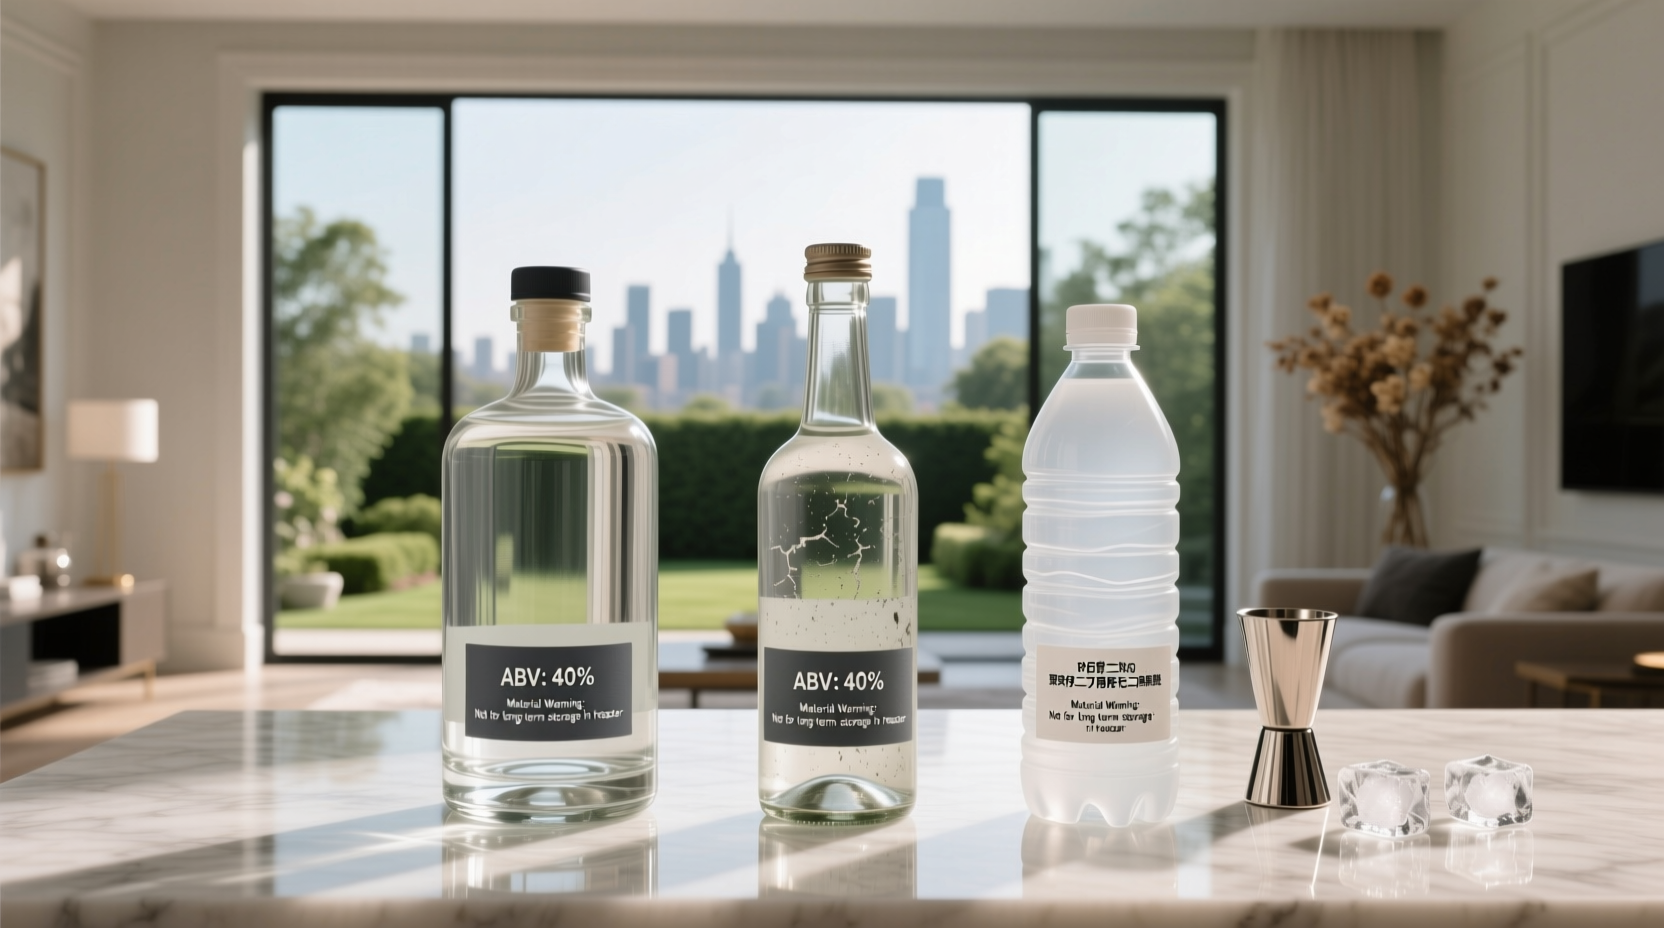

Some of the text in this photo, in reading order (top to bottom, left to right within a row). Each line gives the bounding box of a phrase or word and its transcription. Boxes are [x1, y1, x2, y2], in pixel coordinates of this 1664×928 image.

[500, 666, 595, 687] ABV: 40%
[793, 670, 884, 691] ABV: 40%
